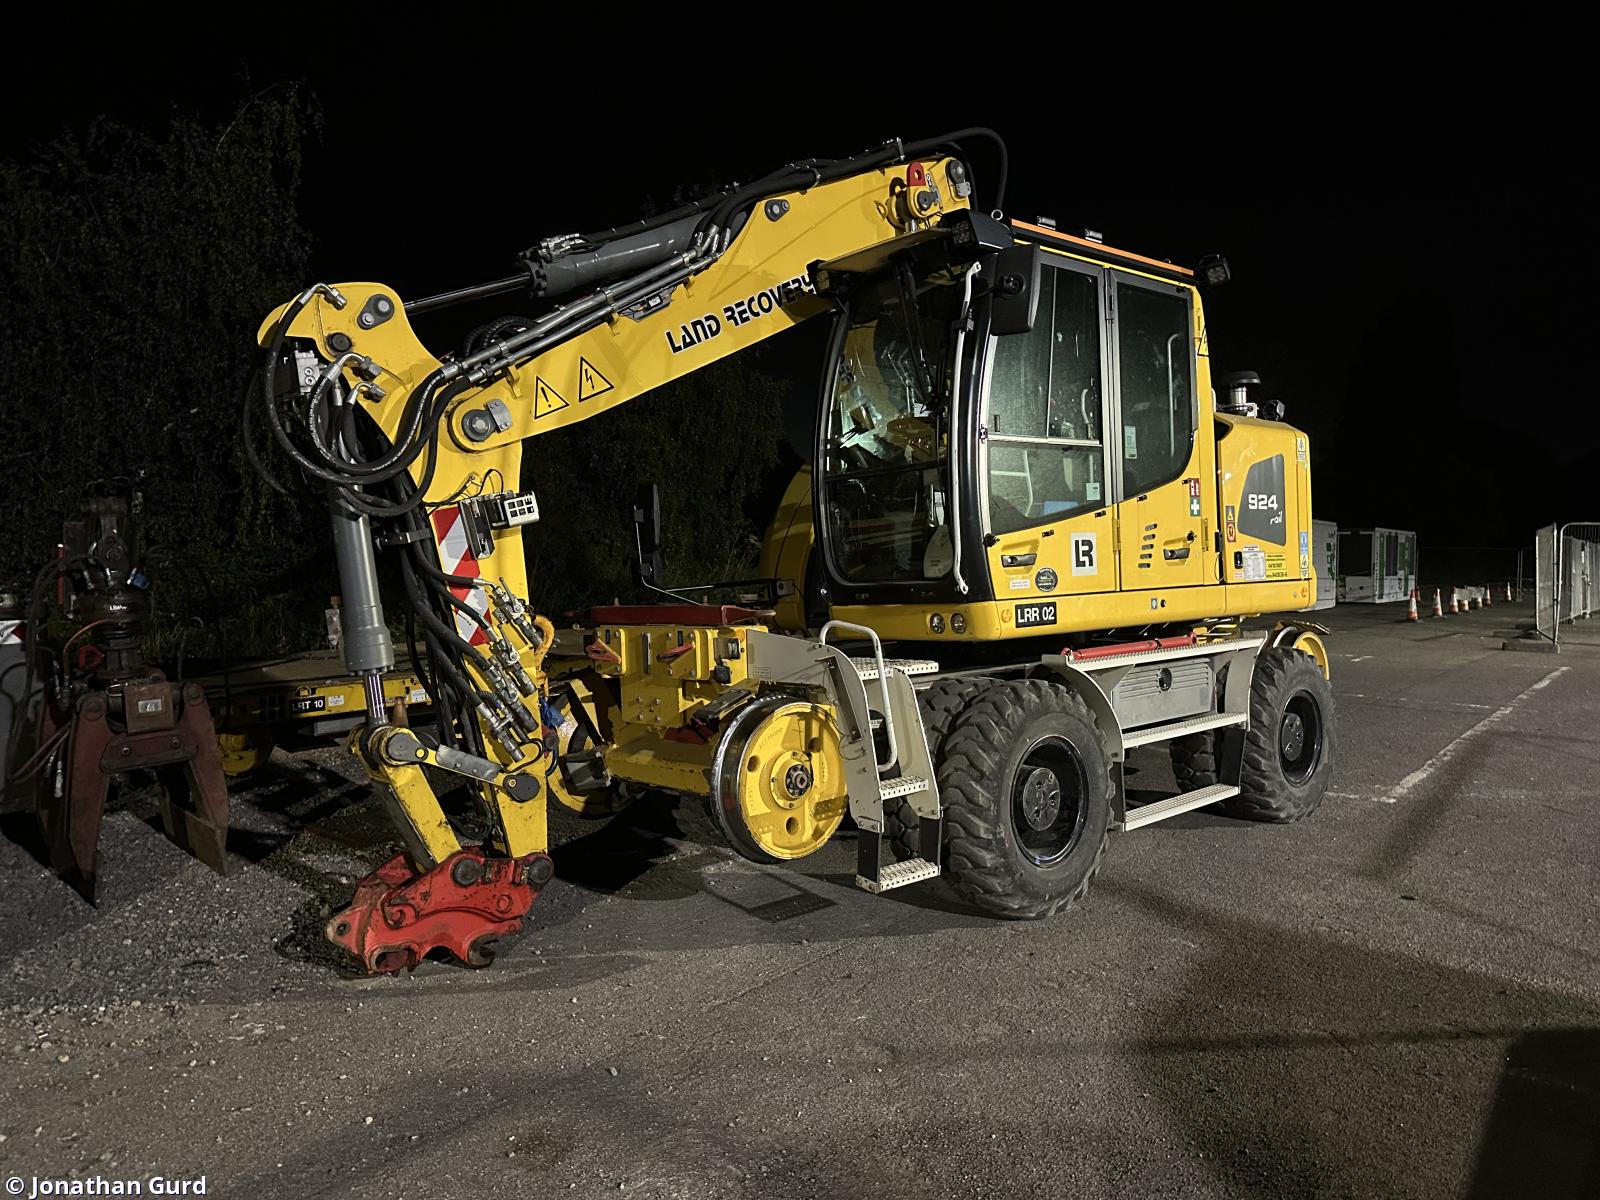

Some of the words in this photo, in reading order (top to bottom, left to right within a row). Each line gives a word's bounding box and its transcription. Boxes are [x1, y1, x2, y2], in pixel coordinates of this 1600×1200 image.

[665, 314, 721, 354] LAND
[723, 273, 816, 327] RECOVERY
[1248, 493, 1279, 511] 924
[1269, 510, 1283, 525] rail
[1017, 607, 1040, 623] LRR
[1042, 606, 1055, 621] 02
[292, 700, 311, 711] LRT
[314, 699, 324, 709] 10
